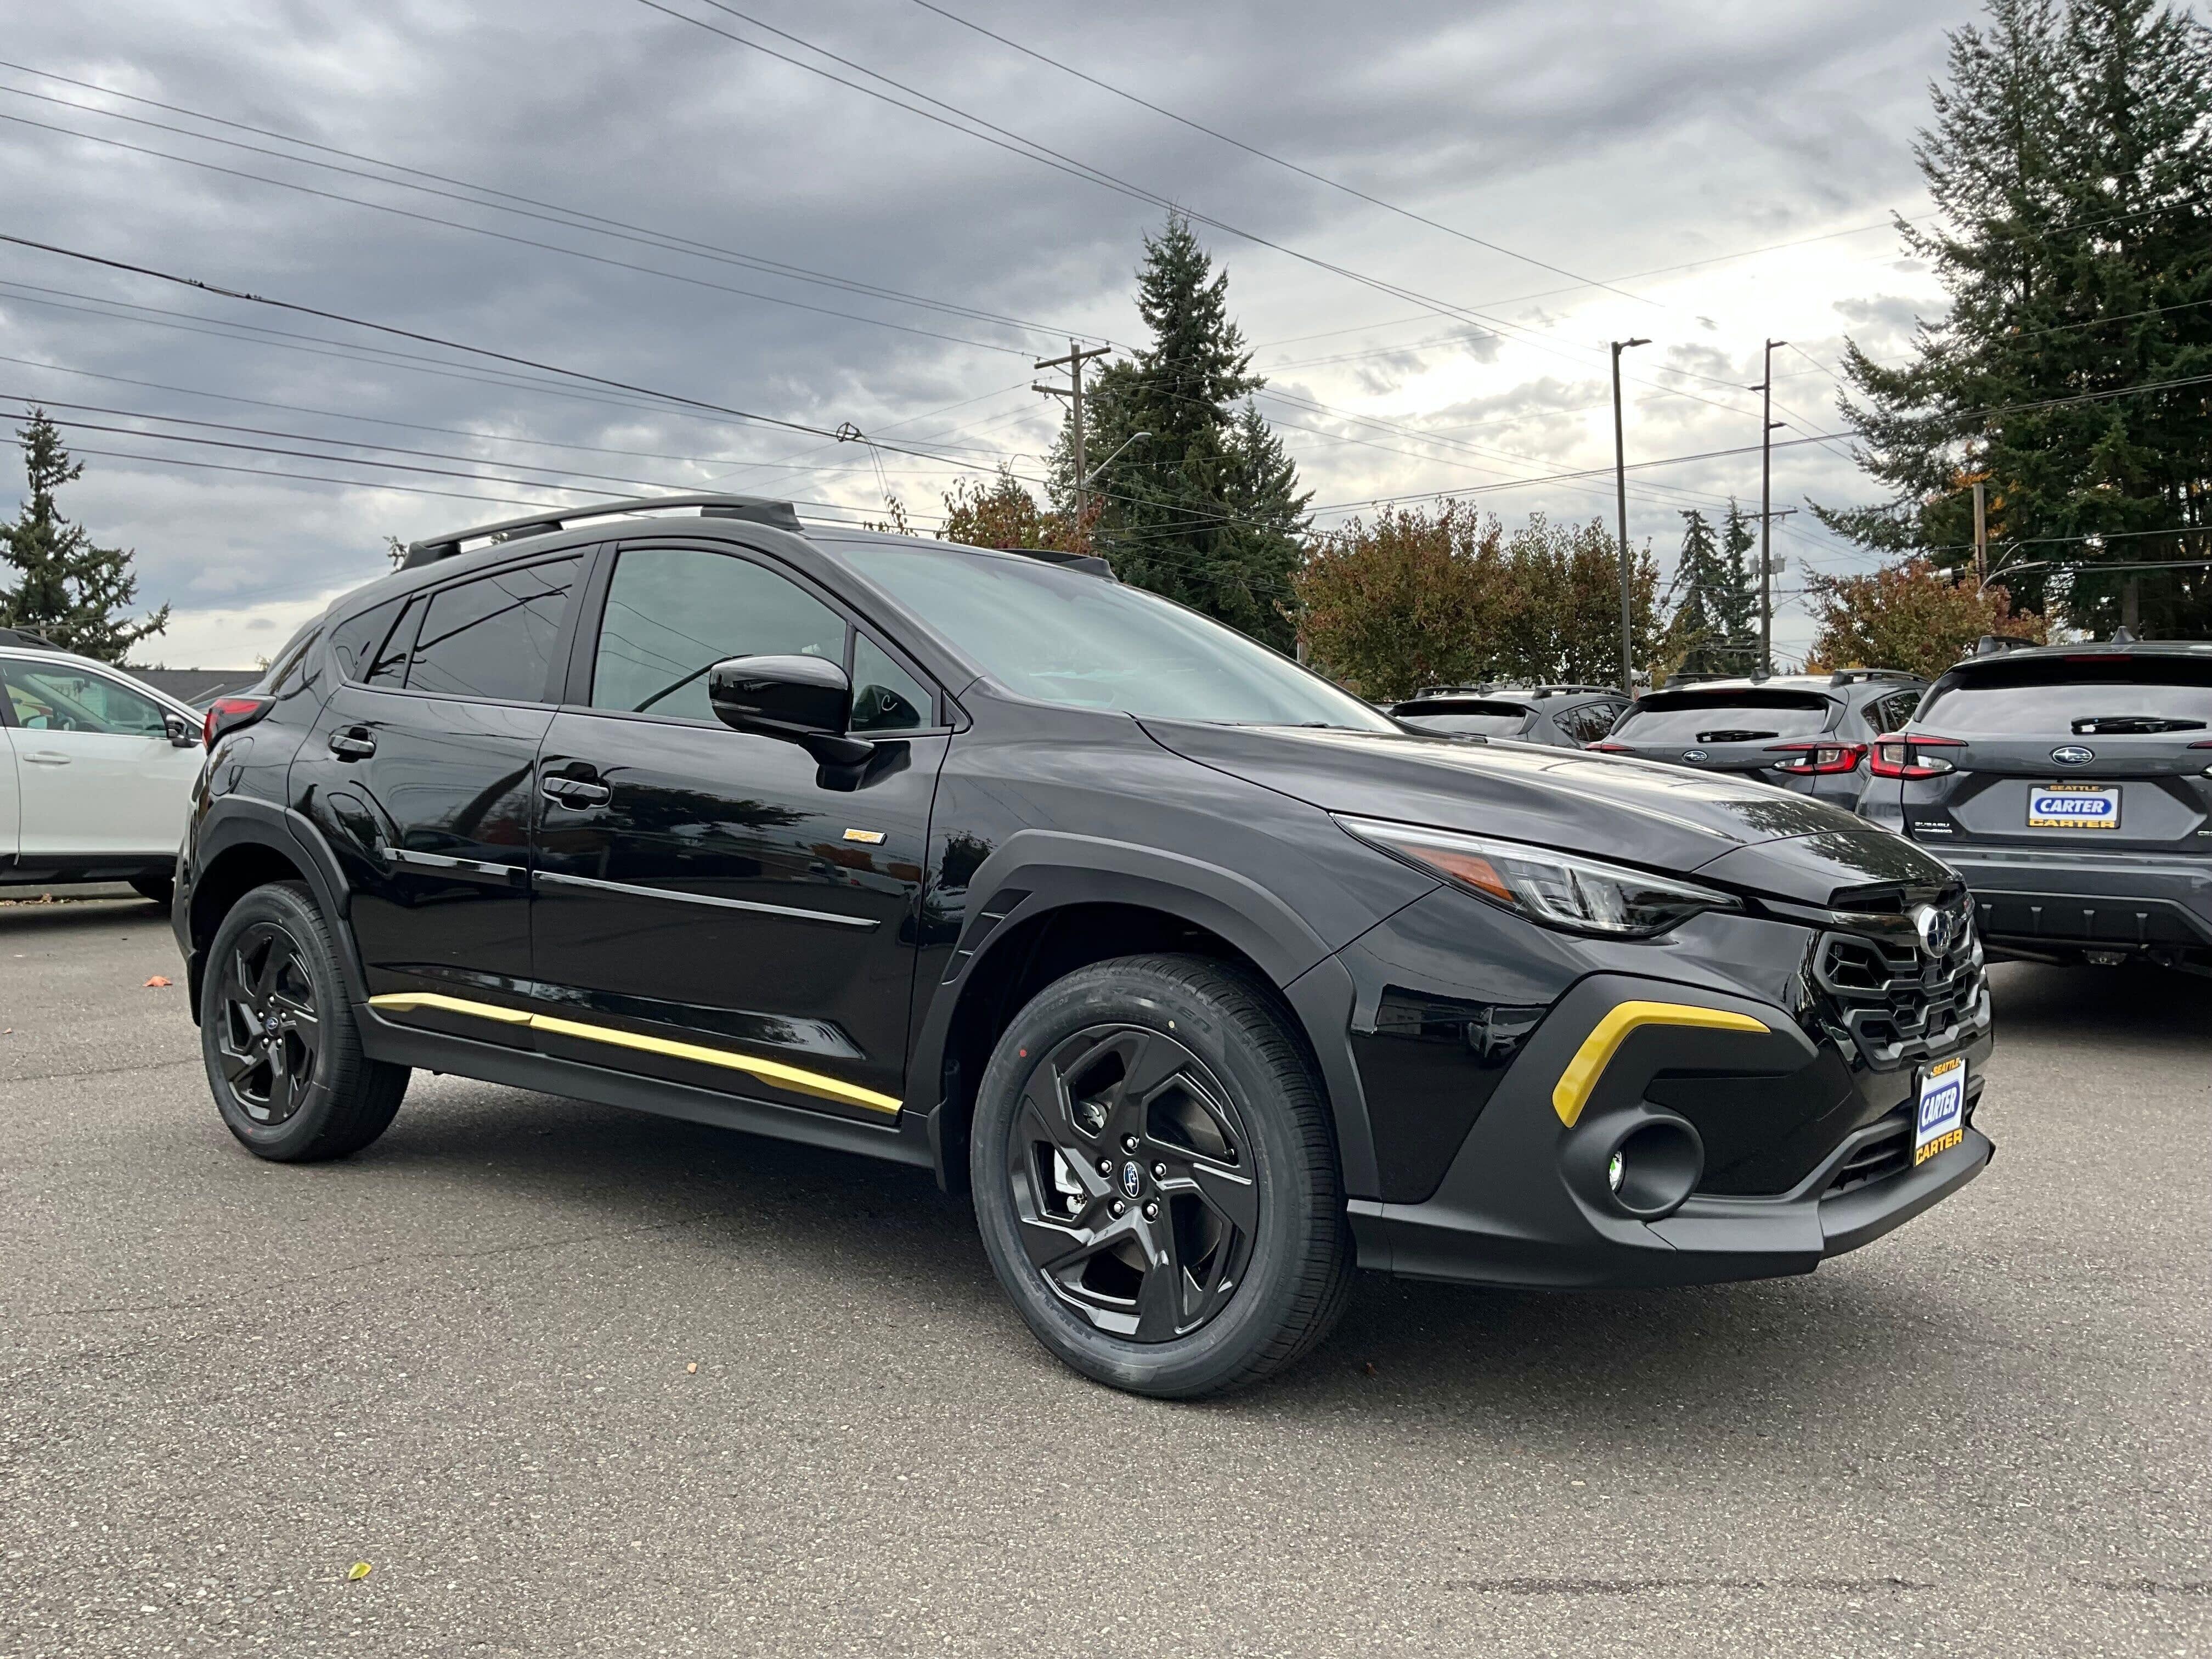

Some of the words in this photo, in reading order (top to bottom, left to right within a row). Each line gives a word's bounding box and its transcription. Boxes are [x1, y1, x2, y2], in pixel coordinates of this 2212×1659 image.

[2040, 799, 2104, 812] CARTER
[2030, 819, 2114, 828] CARTER
[1933, 1057, 1960, 1076] SEATTLE
[1921, 1087, 1957, 1127] CARTER
[1915, 1129, 1963, 1166] CARTER
